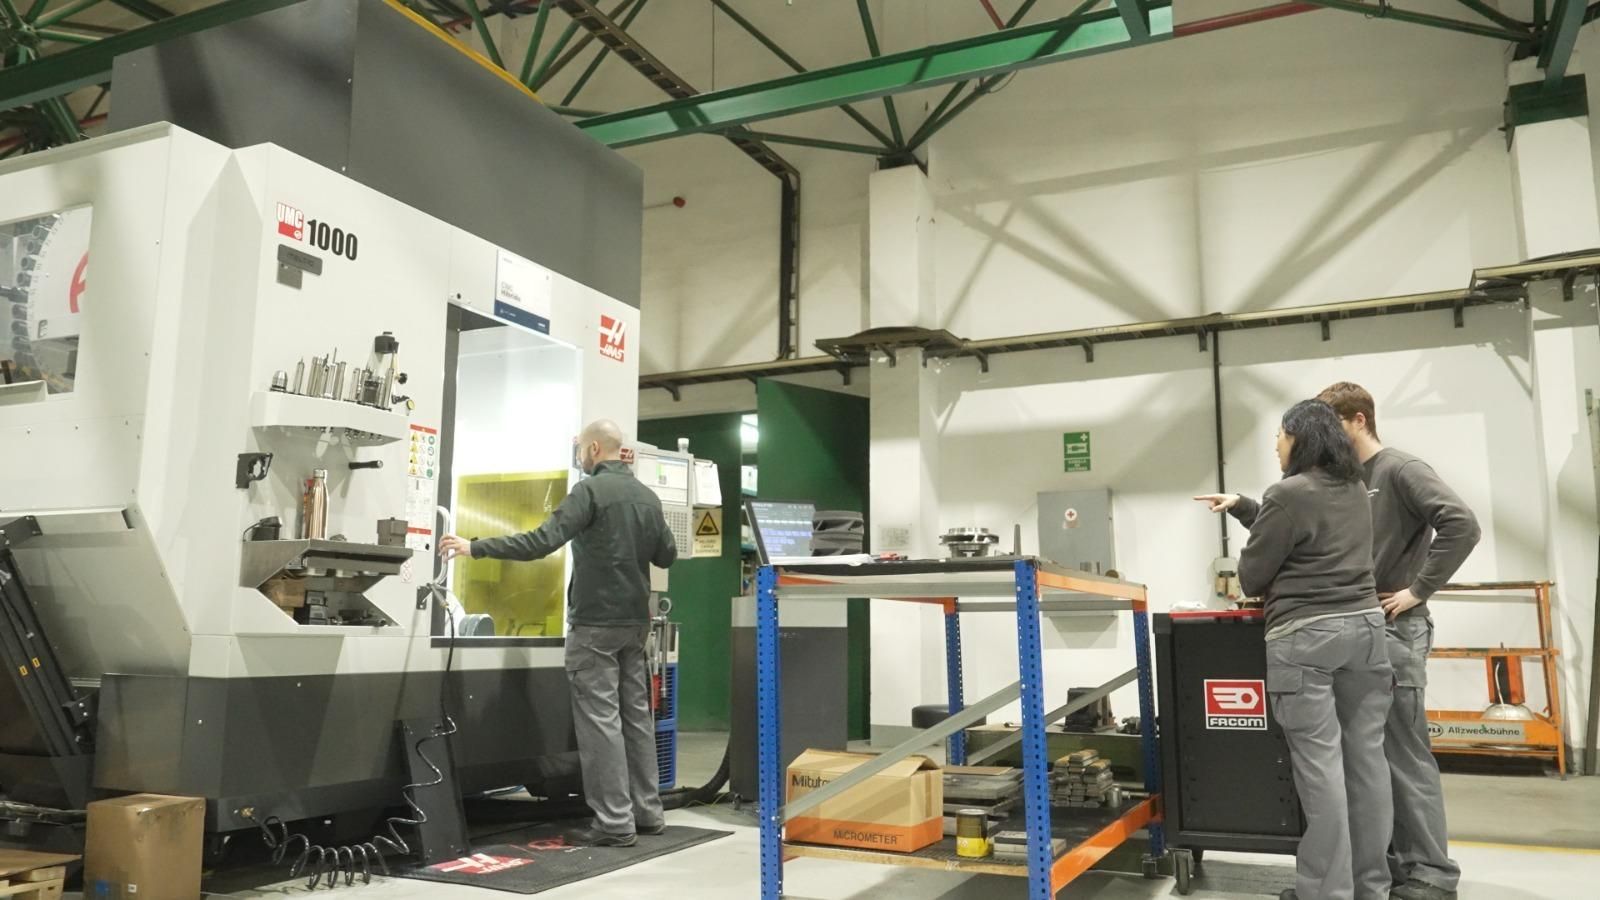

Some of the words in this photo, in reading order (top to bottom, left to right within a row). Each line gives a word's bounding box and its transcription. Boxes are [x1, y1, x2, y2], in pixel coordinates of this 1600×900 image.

[277, 202, 304, 230] UMC
[307, 219, 358, 261] 1000
[1209, 717, 1264, 727] FACOM
[1447, 725, 1520, 736] Allzweckbühne
[791, 774, 832, 789] Mituto
[833, 829, 898, 845] MICROMETER
